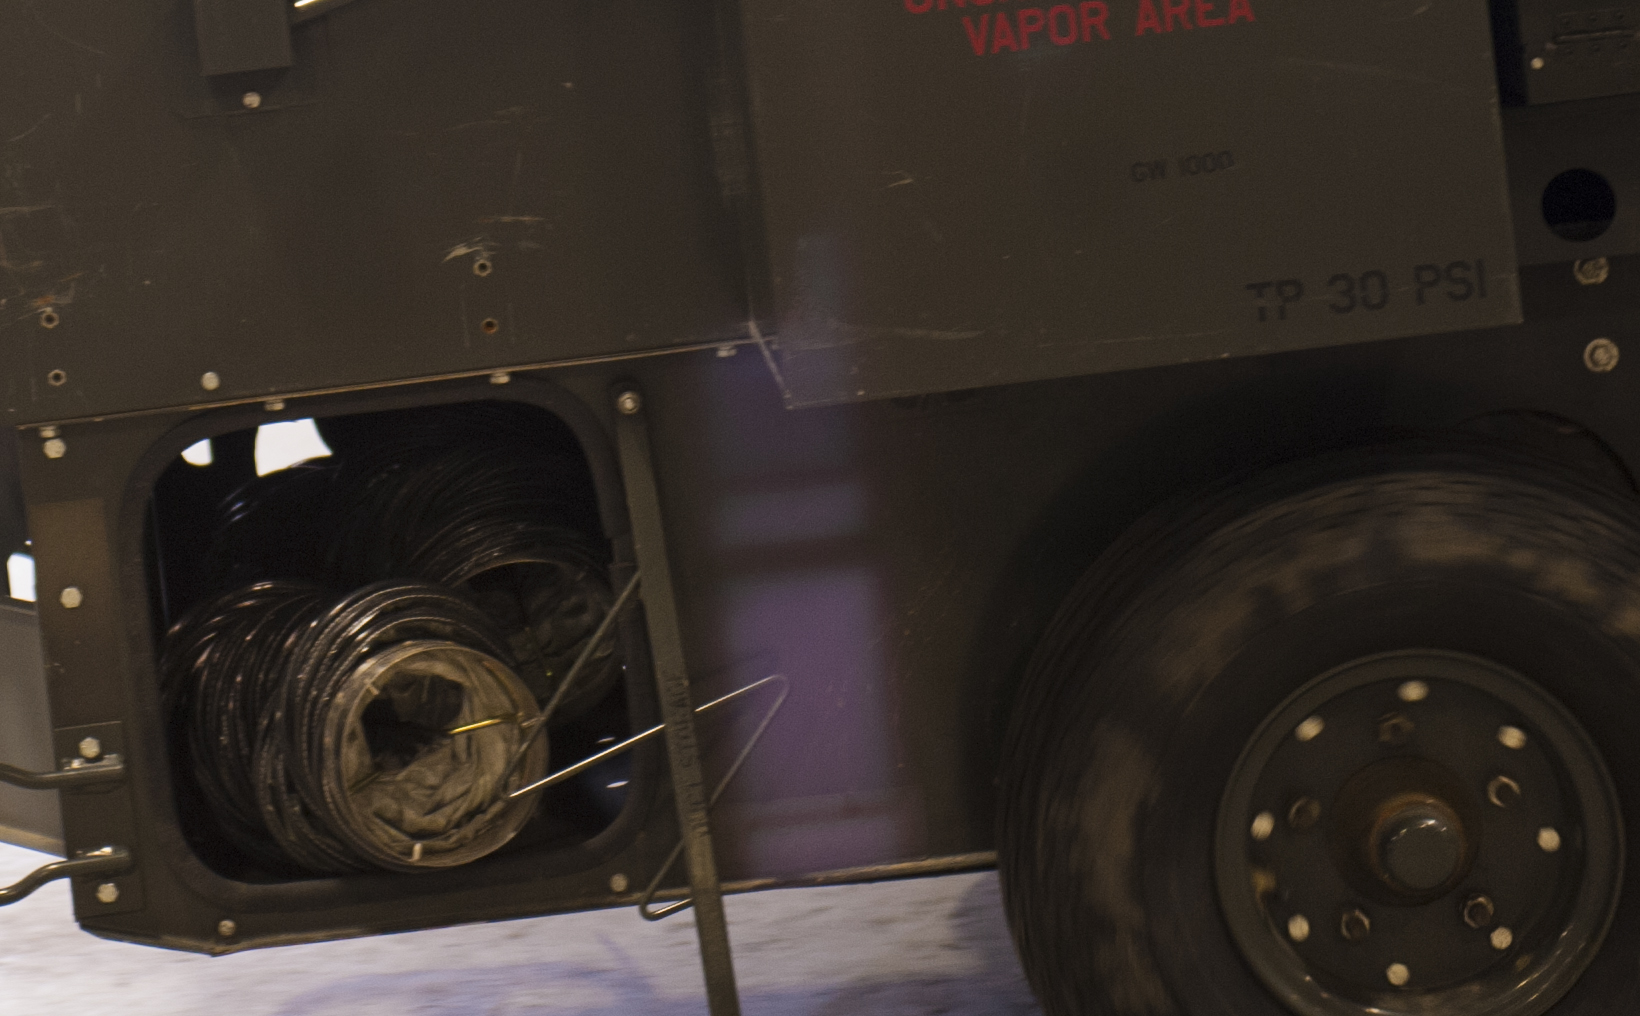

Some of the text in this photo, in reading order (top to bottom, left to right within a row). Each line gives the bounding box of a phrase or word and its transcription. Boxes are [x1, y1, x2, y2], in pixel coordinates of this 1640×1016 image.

[962, 0, 1110, 56] VAPOR
[1245, 258, 1488, 322] TP 30 PSI
